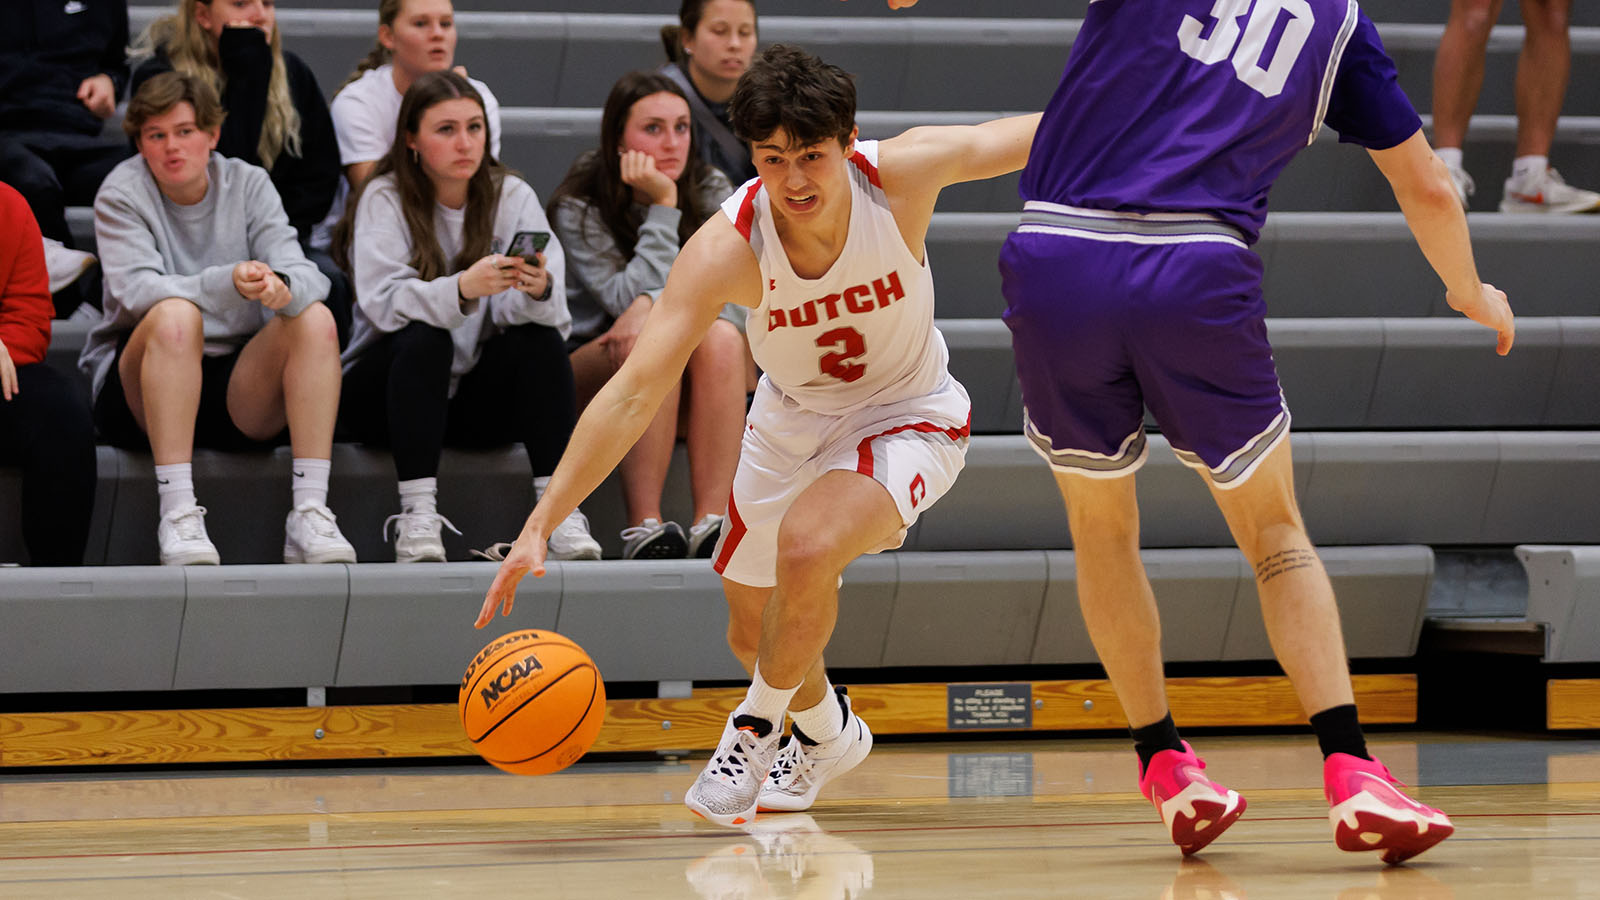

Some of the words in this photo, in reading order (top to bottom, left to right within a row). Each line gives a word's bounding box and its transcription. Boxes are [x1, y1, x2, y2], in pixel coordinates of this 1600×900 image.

[1177, 0, 1316, 98] 30
[768, 270, 905, 332] DUTCH
[815, 326, 867, 383] 2
[909, 472, 926, 509] C
[480, 654, 543, 709] NCAA
